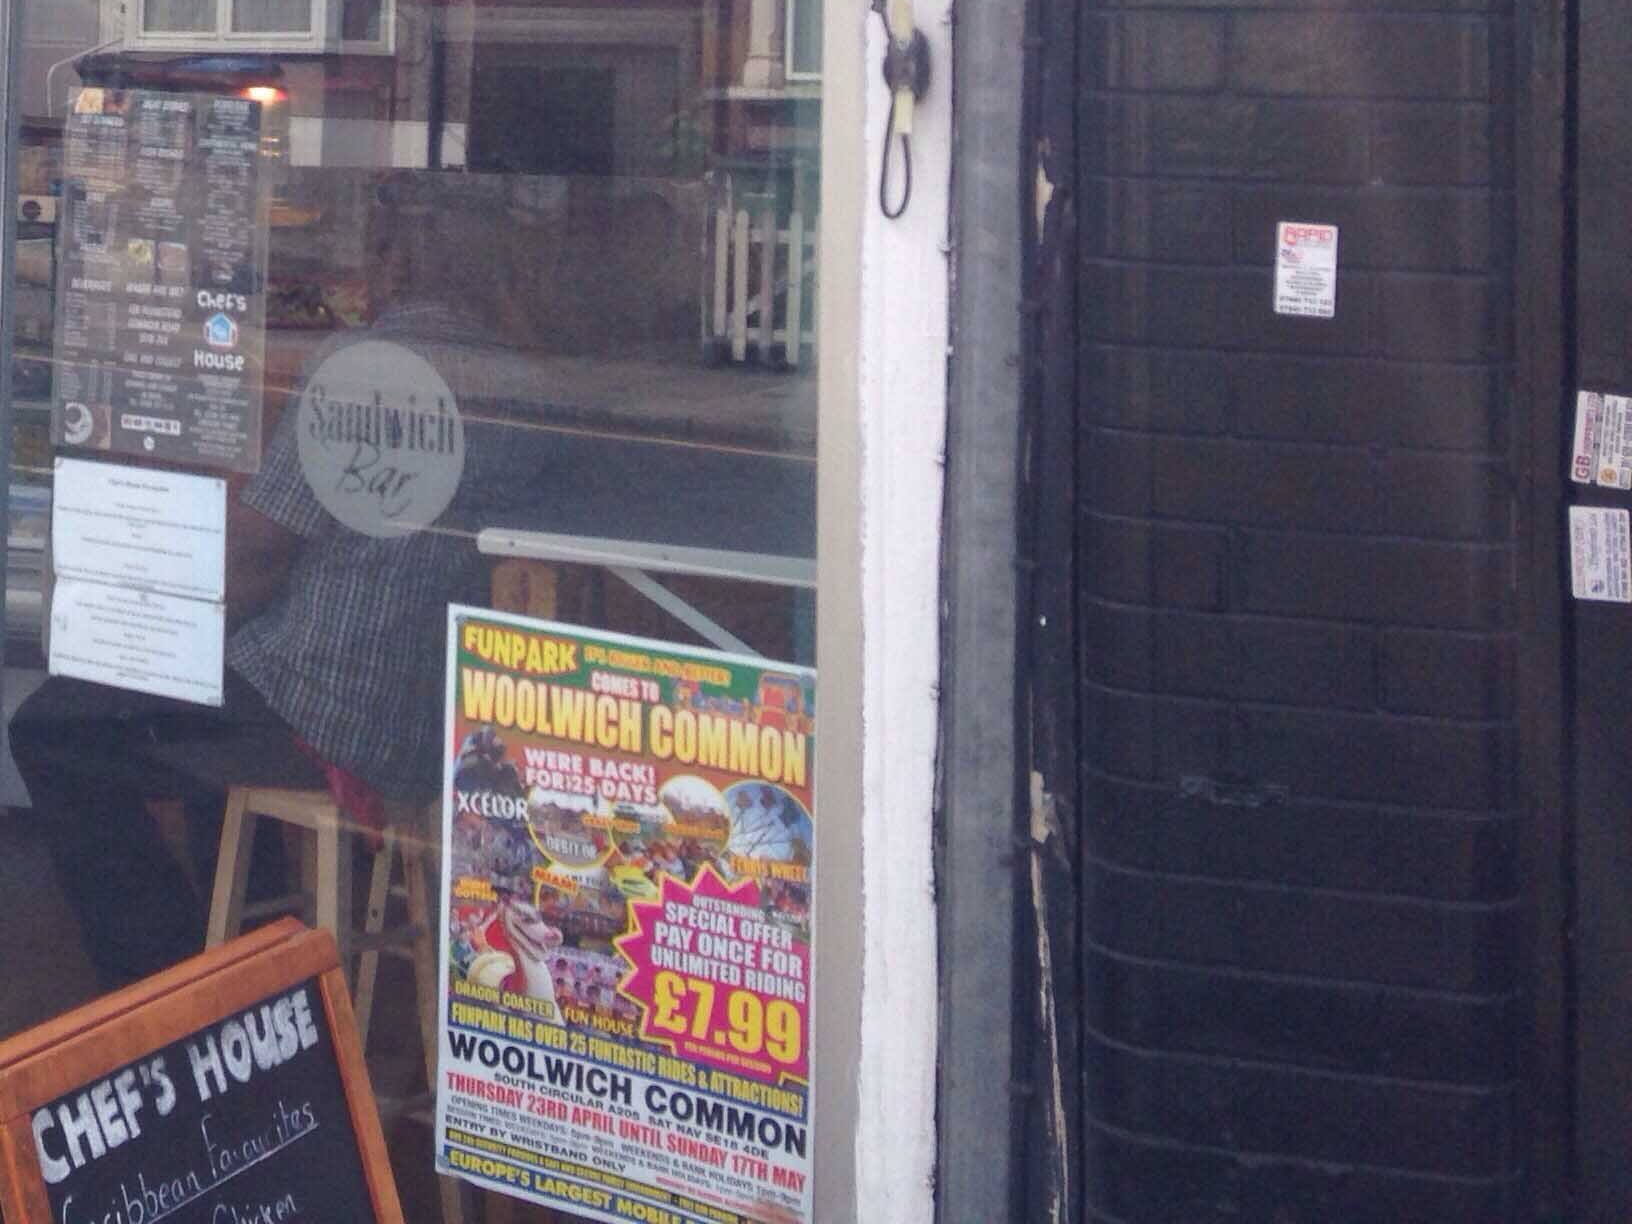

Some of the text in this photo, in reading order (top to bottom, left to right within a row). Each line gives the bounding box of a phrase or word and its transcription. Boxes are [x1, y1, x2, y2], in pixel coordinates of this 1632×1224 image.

[464, 624, 577, 674] FUNPARK
[461, 667, 806, 788] WOOLWICH COMMON
[601, 779, 657, 804] DAYS
[654, 921, 803, 979] PAY ONCE FOR
[665, 901, 793, 951] SPECIAL OFFER
[651, 944, 806, 1004] UNLIMITED RIDING
[653, 970, 802, 1065] £7.99
[31, 988, 319, 1185] CHEF'S HOUSE
[448, 1030, 633, 1107] WOOLWICH
[645, 1085, 807, 1159] COMMON
[494, 1072, 537, 1092] SOUTH
[539, 1085, 605, 1112] CIRCULAR
[445, 1113, 486, 1132] ENTRY
[489, 1126, 506, 1138] BY
[510, 1133, 588, 1162] WRISTBAND
[592, 1155, 626, 1173] ONLY
[446, 1071, 808, 1193] THURSDAY 23RD APRIL UNTIL SUNDAY 17TH MAY
[62, 1172, 201, 1224] Cribbean
[535, 1174, 612, 1208] LARGEST
